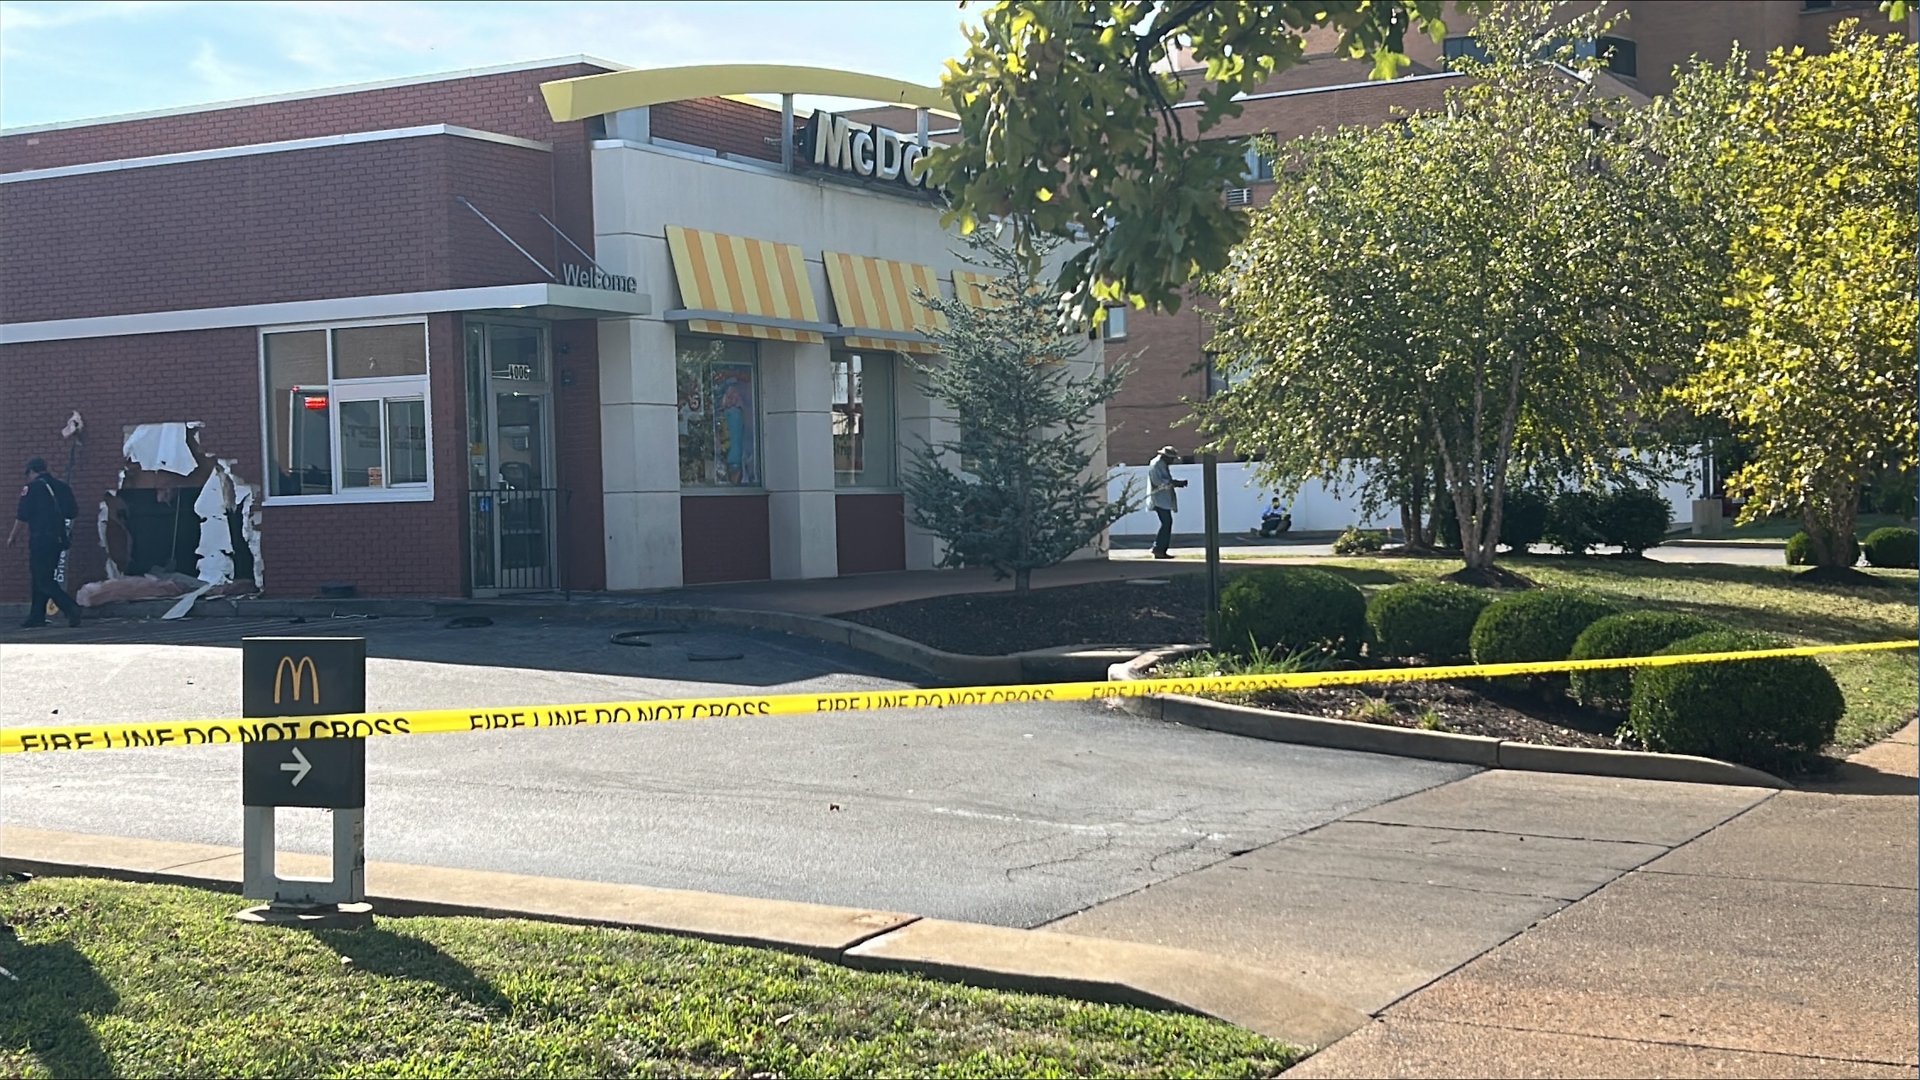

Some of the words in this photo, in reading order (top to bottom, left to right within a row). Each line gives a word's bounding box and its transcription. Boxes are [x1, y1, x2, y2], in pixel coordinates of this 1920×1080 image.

[815, 111, 932, 187] McDo
[562, 262, 638, 294] Welcome
[469, 712, 525, 731] FIRE
[595, 707, 632, 724] DO
[20, 731, 95, 752] FIRE
[183, 726, 231, 745] DO
[238, 722, 300, 743] NOT
